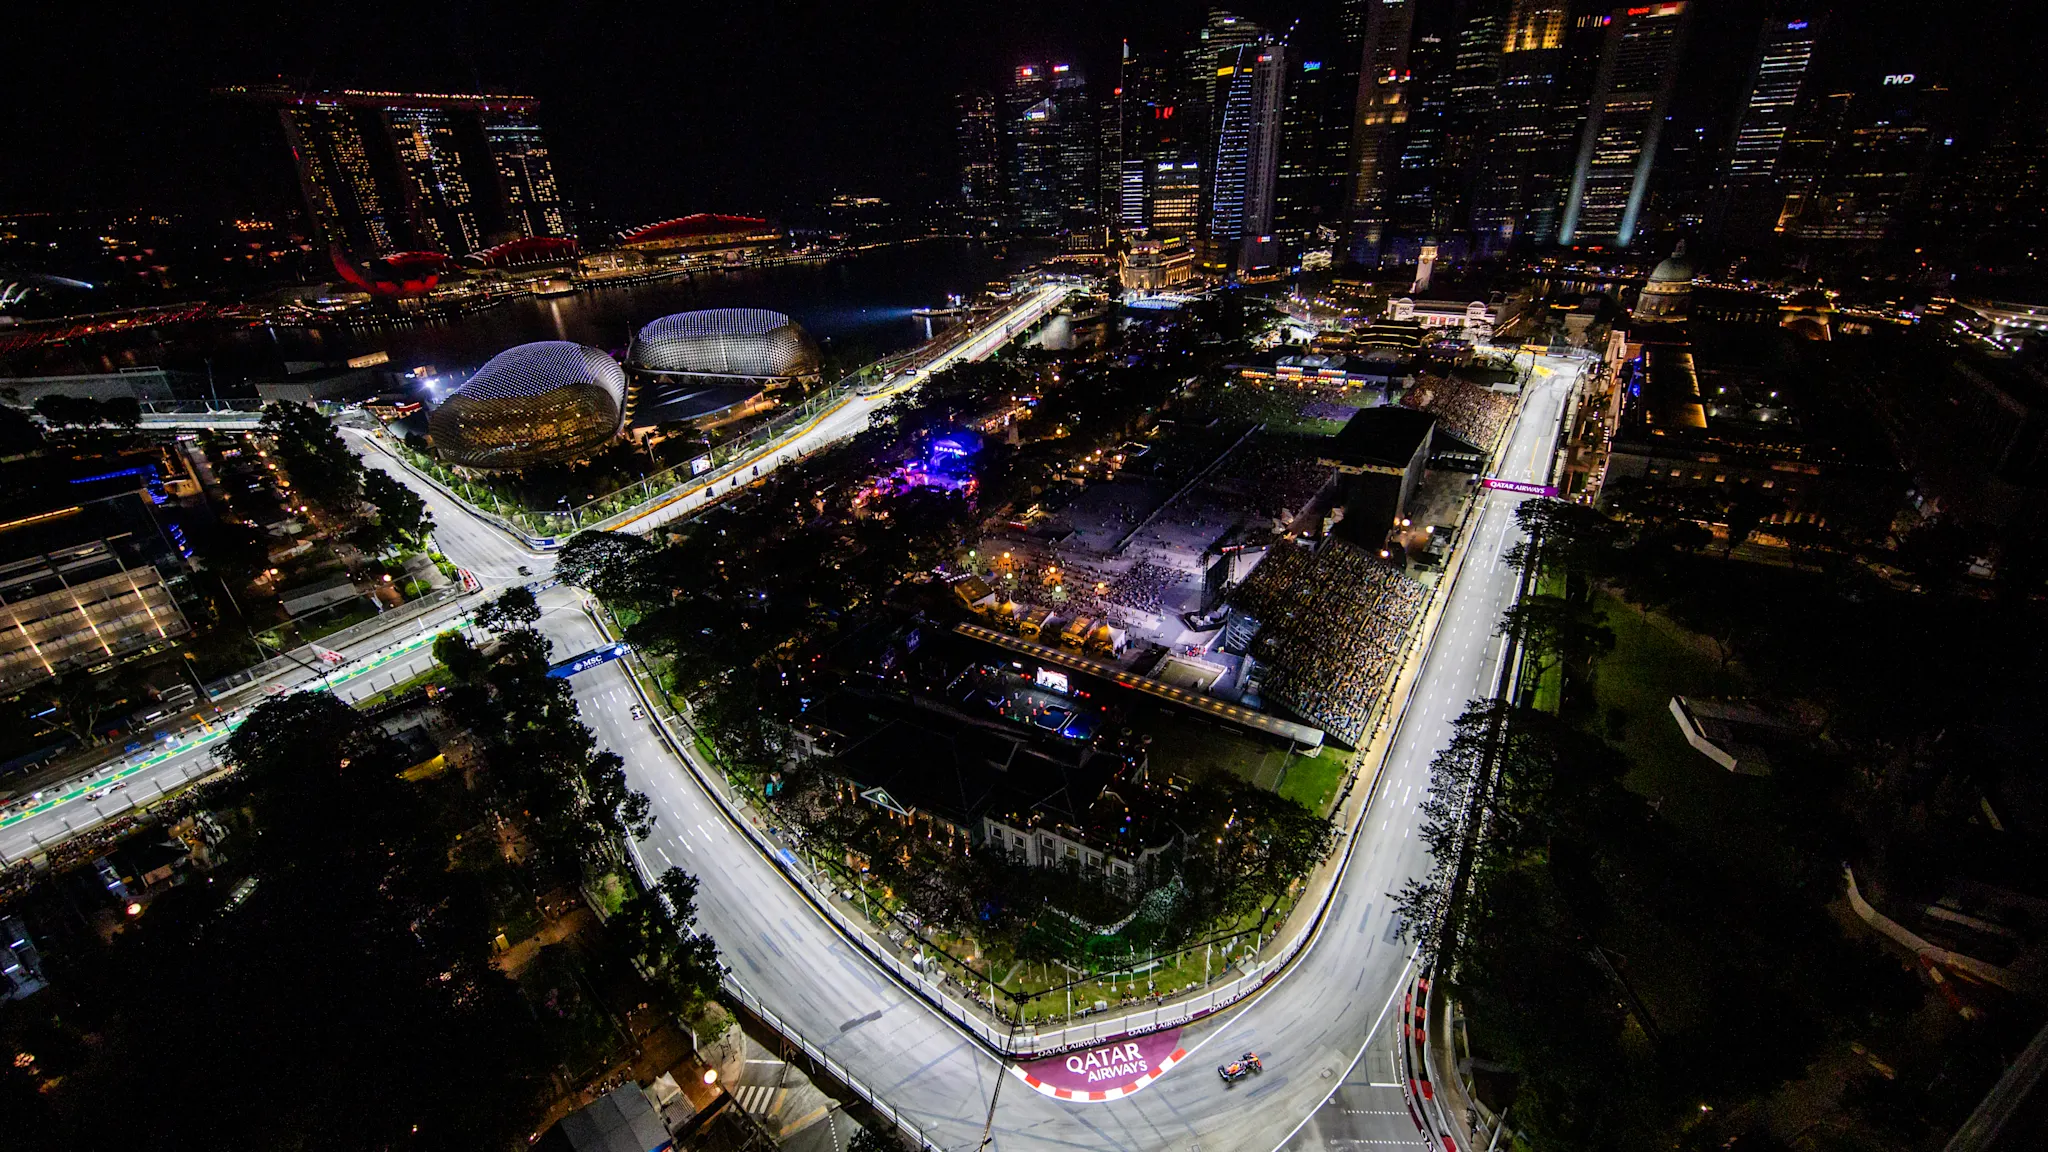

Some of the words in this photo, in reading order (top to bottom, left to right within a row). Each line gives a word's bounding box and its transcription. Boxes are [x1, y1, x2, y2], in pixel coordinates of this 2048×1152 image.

[1883, 74, 1915, 85] FWD
[1490, 481, 1514, 489] QATAR
[1514, 484, 1545, 494] AIRWAYS
[582, 655, 603, 667] MSC
[1128, 1024, 1157, 1036] QATAR
[1158, 1015, 1193, 1029] AIRWAYS
[1038, 1045, 1067, 1057] QATAR
[1070, 1037, 1107, 1050] AIRWAYS
[1066, 1043, 1143, 1074] QATAR
[1088, 1060, 1147, 1083] AIRWAYS
